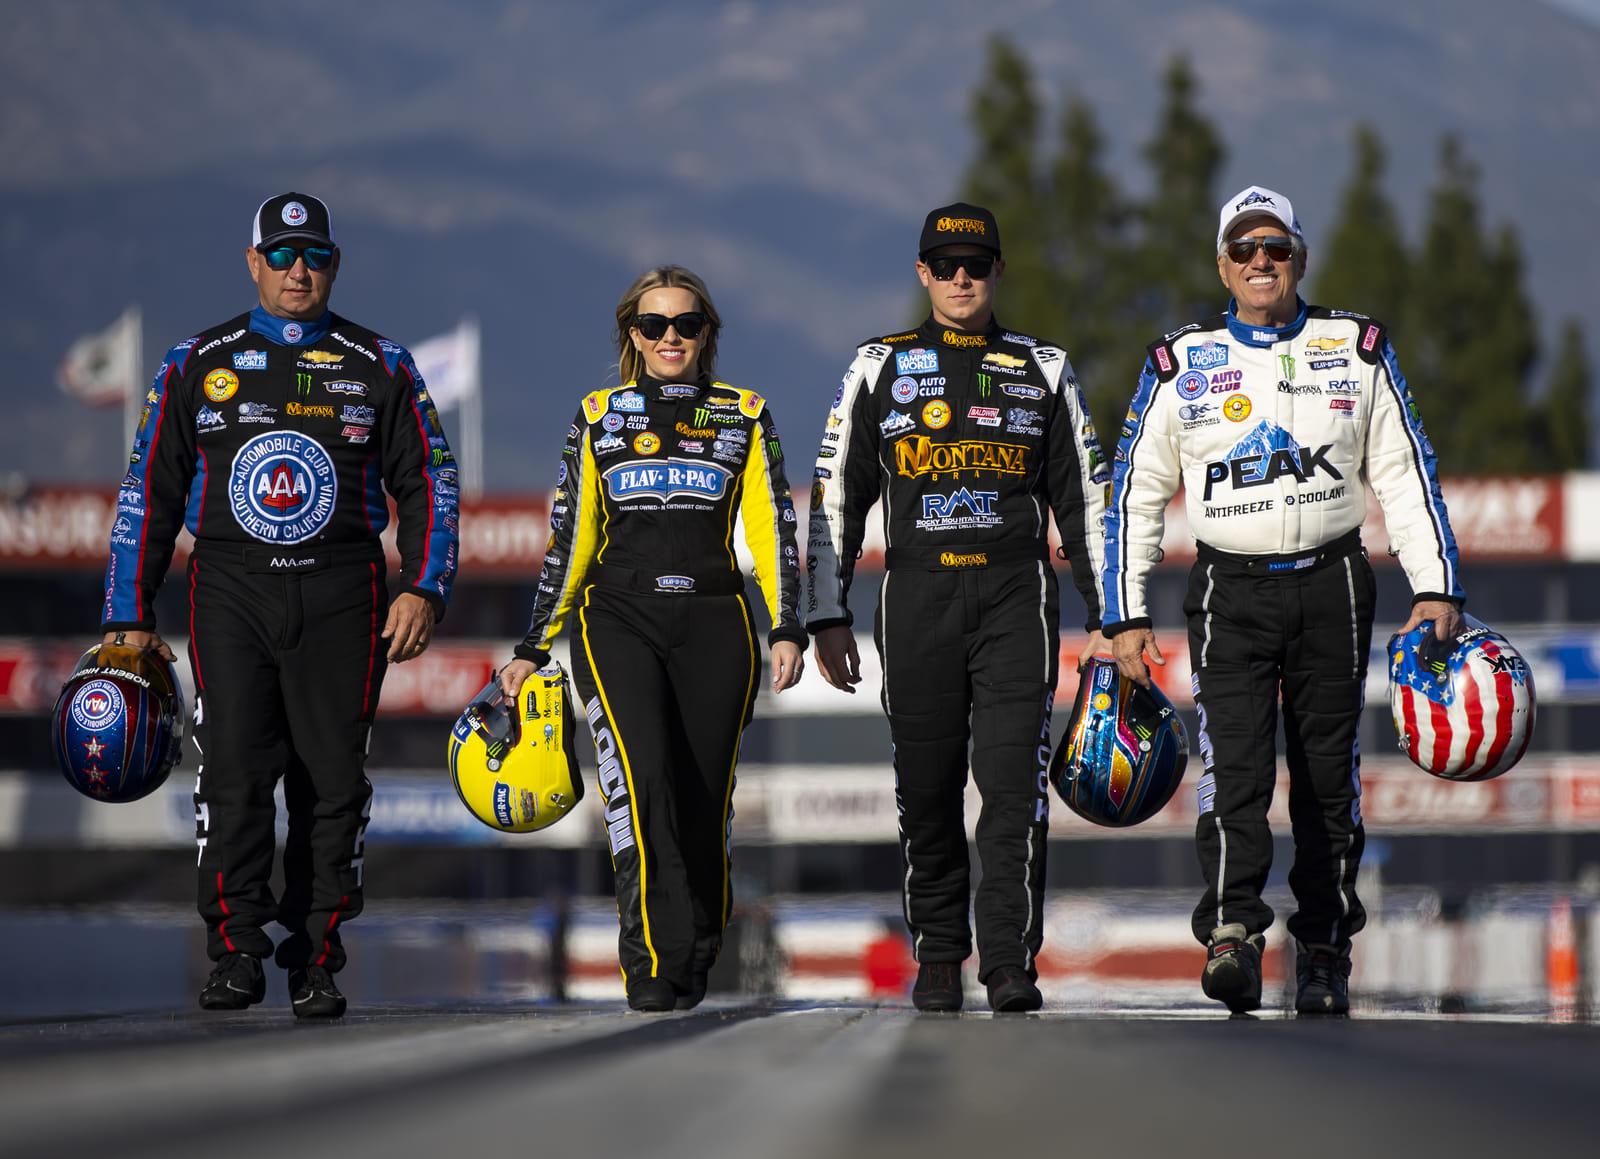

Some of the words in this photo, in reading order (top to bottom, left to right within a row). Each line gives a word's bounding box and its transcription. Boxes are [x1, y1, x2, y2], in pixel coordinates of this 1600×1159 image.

[1236, 196, 1275, 212] PEAK
[198, 339, 221, 356] AUTO
[330, 332, 354, 348] AUTO
[354, 344, 377, 362] CLUB
[1190, 346, 1227, 357] CAMPING
[1305, 348, 1351, 357] CHEVROLET
[898, 353, 937, 362] CAMPING
[1191, 353, 1227, 365] WORLD
[296, 361, 344, 370] CHEVROLET
[899, 360, 937, 370] WORLD
[981, 363, 1027, 376] CHEVROLET
[920, 377, 946, 386] AUTO
[1211, 370, 1243, 384] AUTO
[1210, 382, 1241, 394] CLUB
[1328, 379, 1360, 390] RMT
[919, 387, 944, 397] CLUB
[627, 415, 650, 423] AUTO
[971, 408, 997, 418] BALDWIN
[626, 422, 647, 430] CLUB
[879, 413, 916, 434] PEAK
[594, 437, 626, 452] PEAK
[236, 437, 302, 480] AUTOMOBILE
[304, 446, 330, 477] CLUB
[894, 435, 1029, 479] MONTANA
[1203, 443, 1344, 501] PEAK
[256, 471, 307, 498] AAA
[922, 486, 998, 519] RMT
[1205, 500, 1274, 518] ANTIFREEZE
[1299, 486, 1345, 505] COOLANT
[233, 484, 279, 539] SOUTHERN
[283, 483, 333, 539] CALIFORNIA
[916, 519, 940, 528] ROCKY
[941, 516, 980, 525] MOUNTAIN
[270, 557, 315, 567] AAA.com
[1456, 628, 1488, 644] FORCE
[101, 667, 150, 688] ROBERT
[85, 697, 108, 712] AAA
